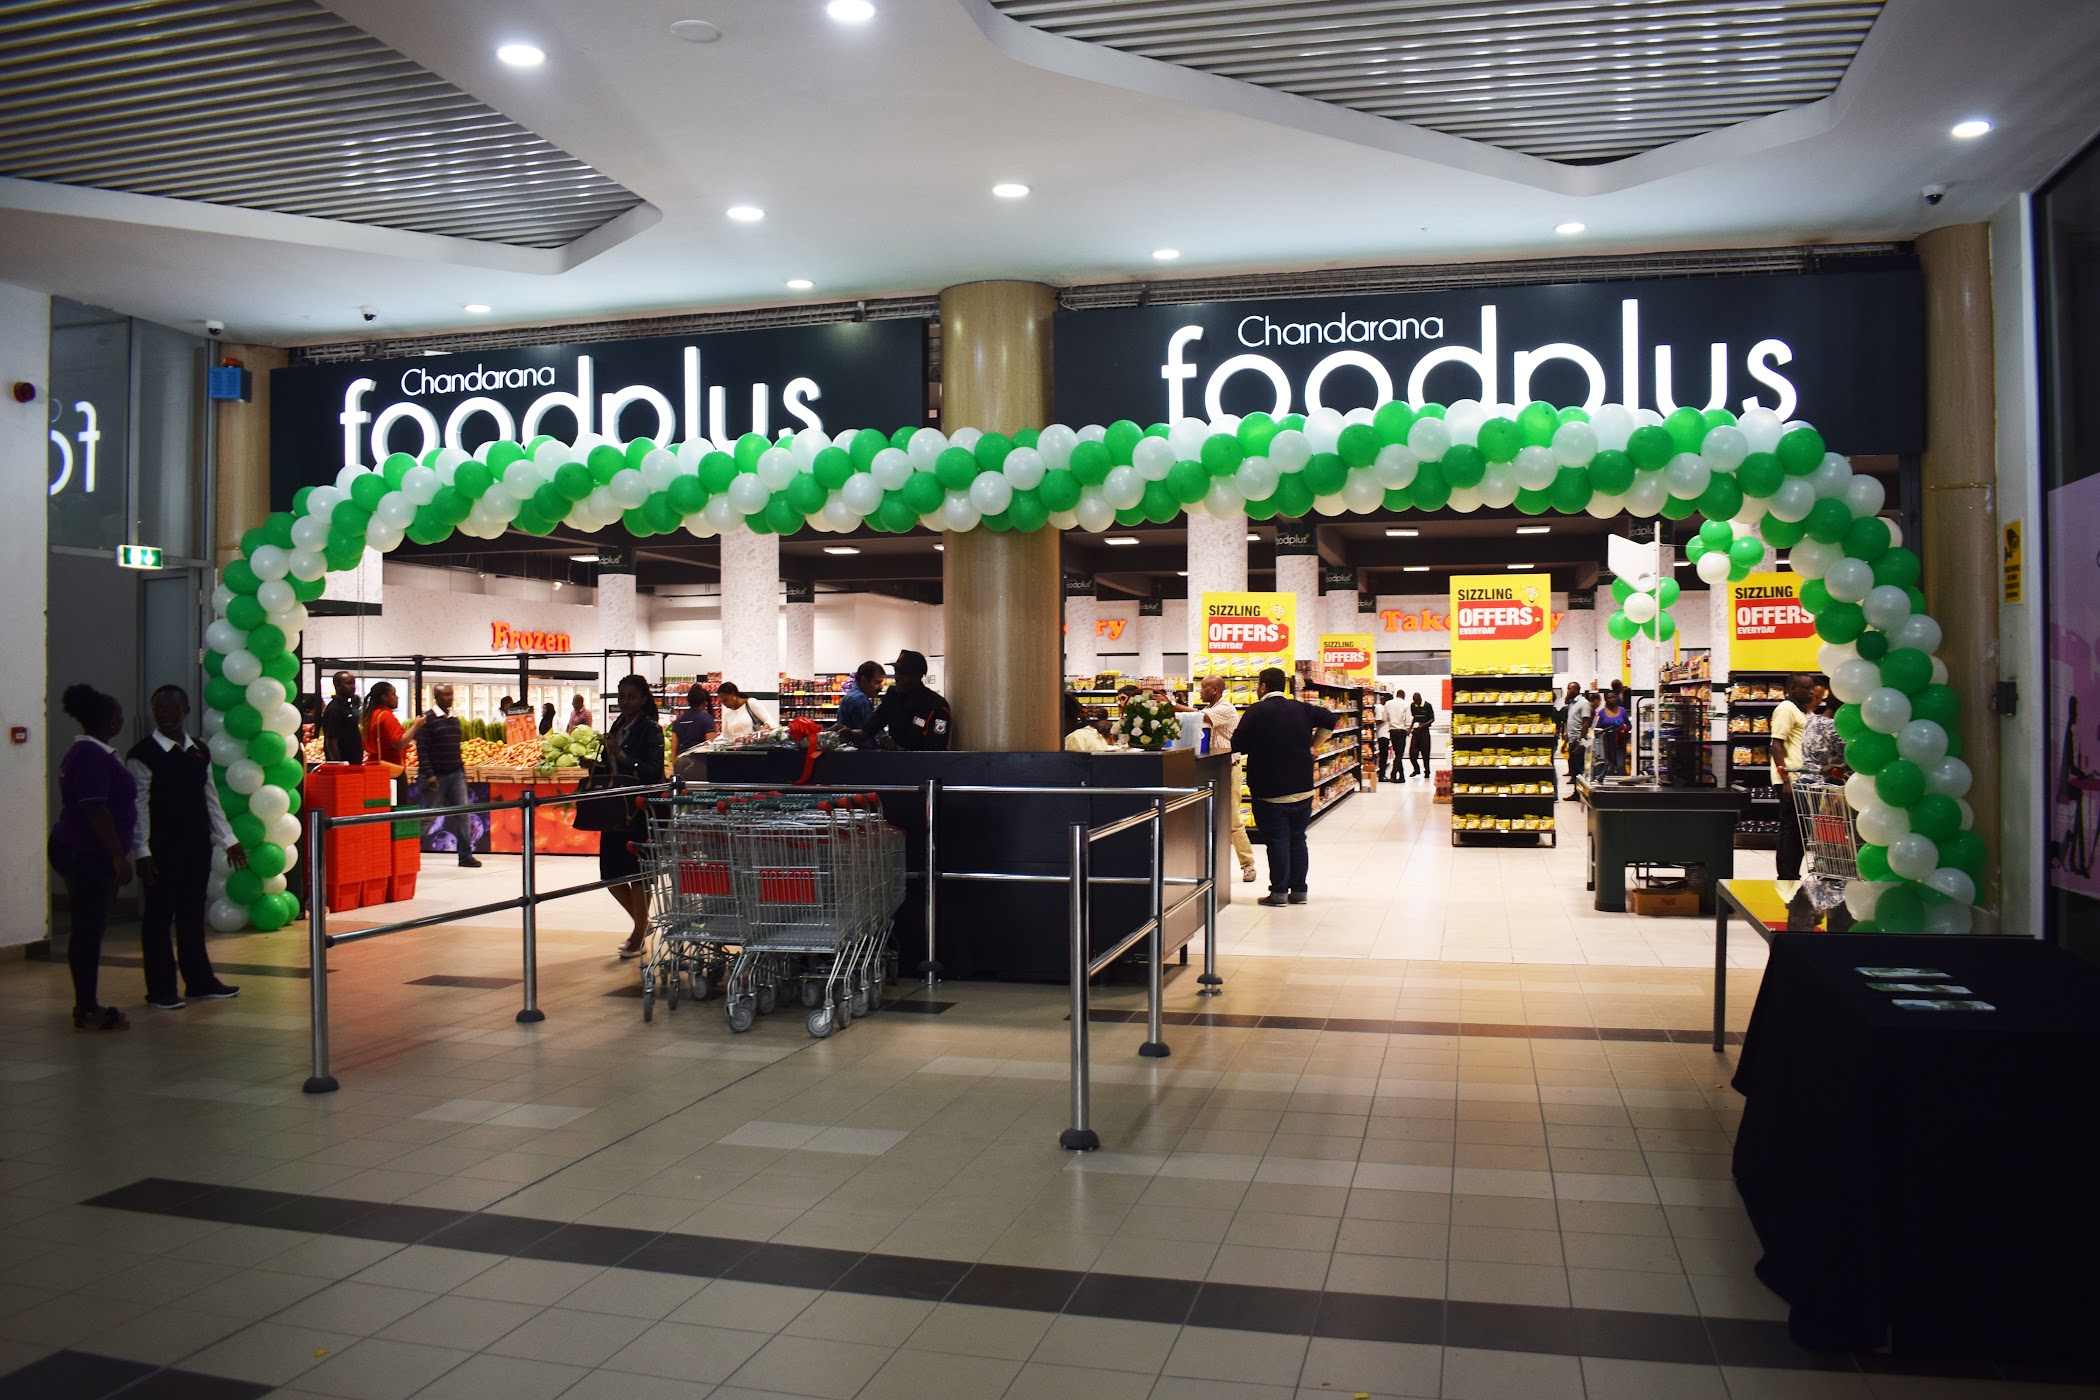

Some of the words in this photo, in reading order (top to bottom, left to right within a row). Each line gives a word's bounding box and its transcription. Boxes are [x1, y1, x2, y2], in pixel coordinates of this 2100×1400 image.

[1237, 311, 1444, 348] Chandarana
[1161, 299, 1798, 428] foodplus
[400, 363, 555, 396] Chandarana
[339, 345, 824, 467] foodplus
[1457, 588, 1513, 600] SIZZLING
[1735, 585, 1793, 600] SIZZLING
[1209, 605, 1261, 616] SIZZLING
[1459, 607, 1533, 627] OFFERS
[1736, 605, 1815, 626] OFFERS
[491, 621, 571, 652] Frozen
[1209, 623, 1279, 642] OFFERS
[1459, 627, 1496, 635] EVERYDAY
[1737, 625, 1776, 634] EVERYDAY
[1324, 651, 1365, 663] OFFERS
